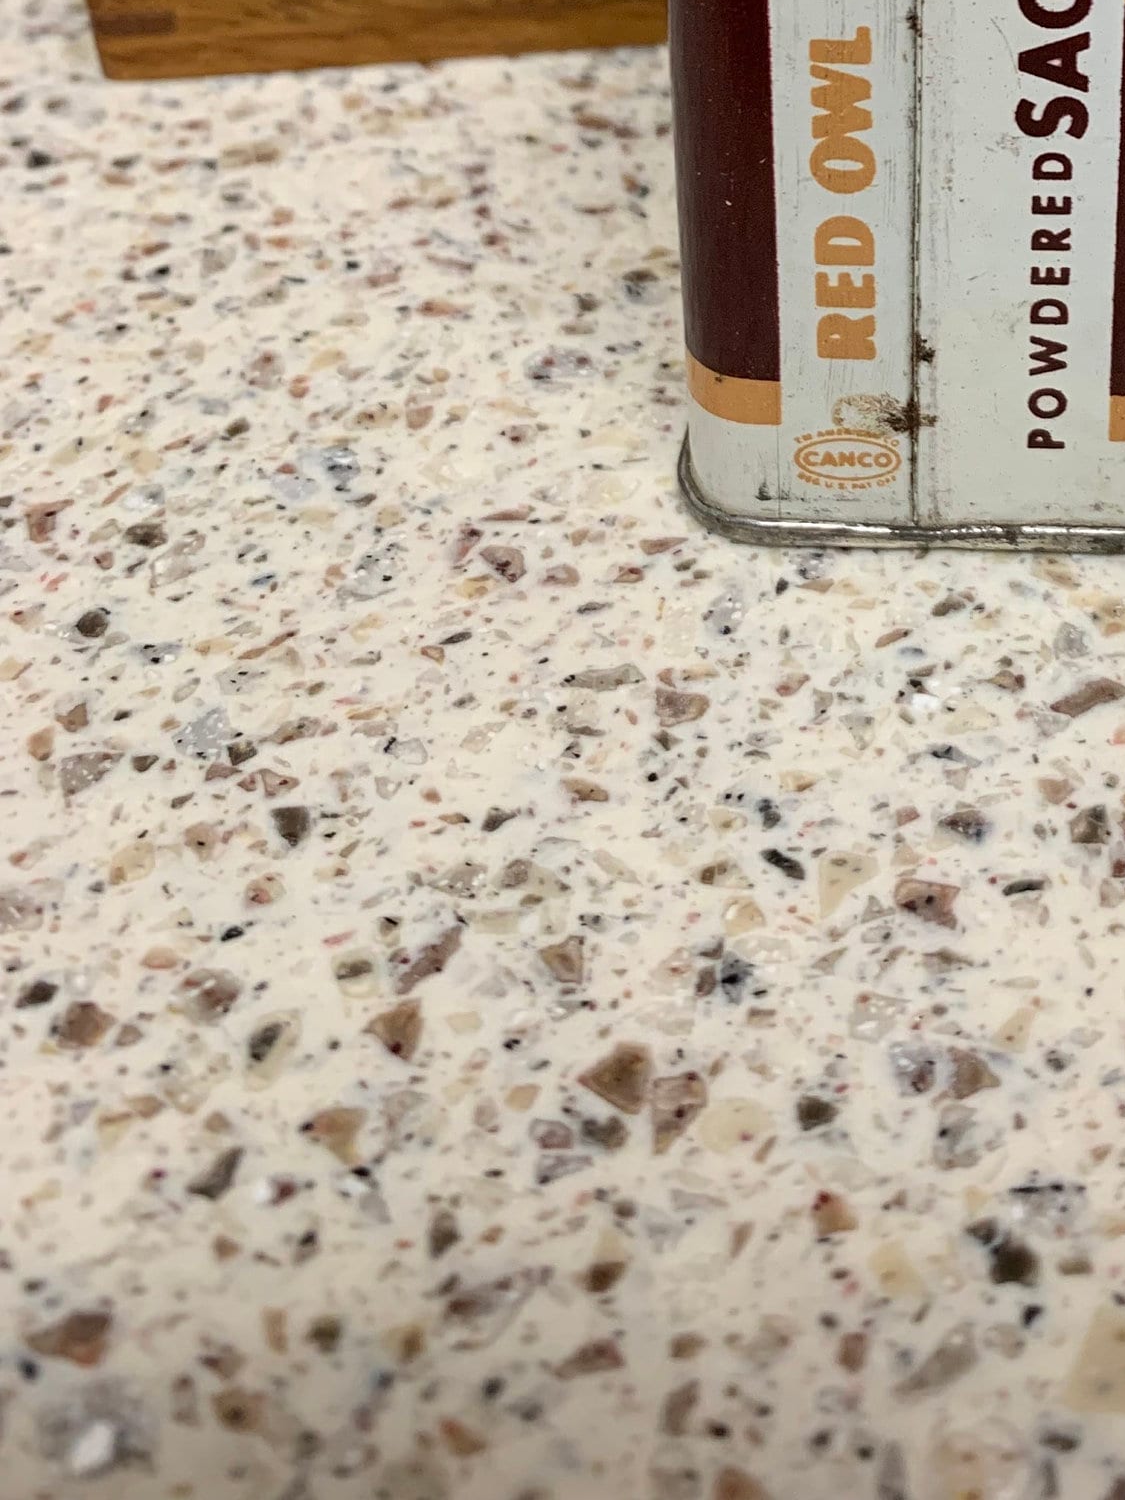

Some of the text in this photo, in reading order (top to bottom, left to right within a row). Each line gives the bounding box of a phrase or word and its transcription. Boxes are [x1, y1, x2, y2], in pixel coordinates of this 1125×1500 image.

[809, 26, 877, 361] RED OWL
[1026, 152, 1073, 450] POWDERED
[802, 451, 893, 468] CANCO
